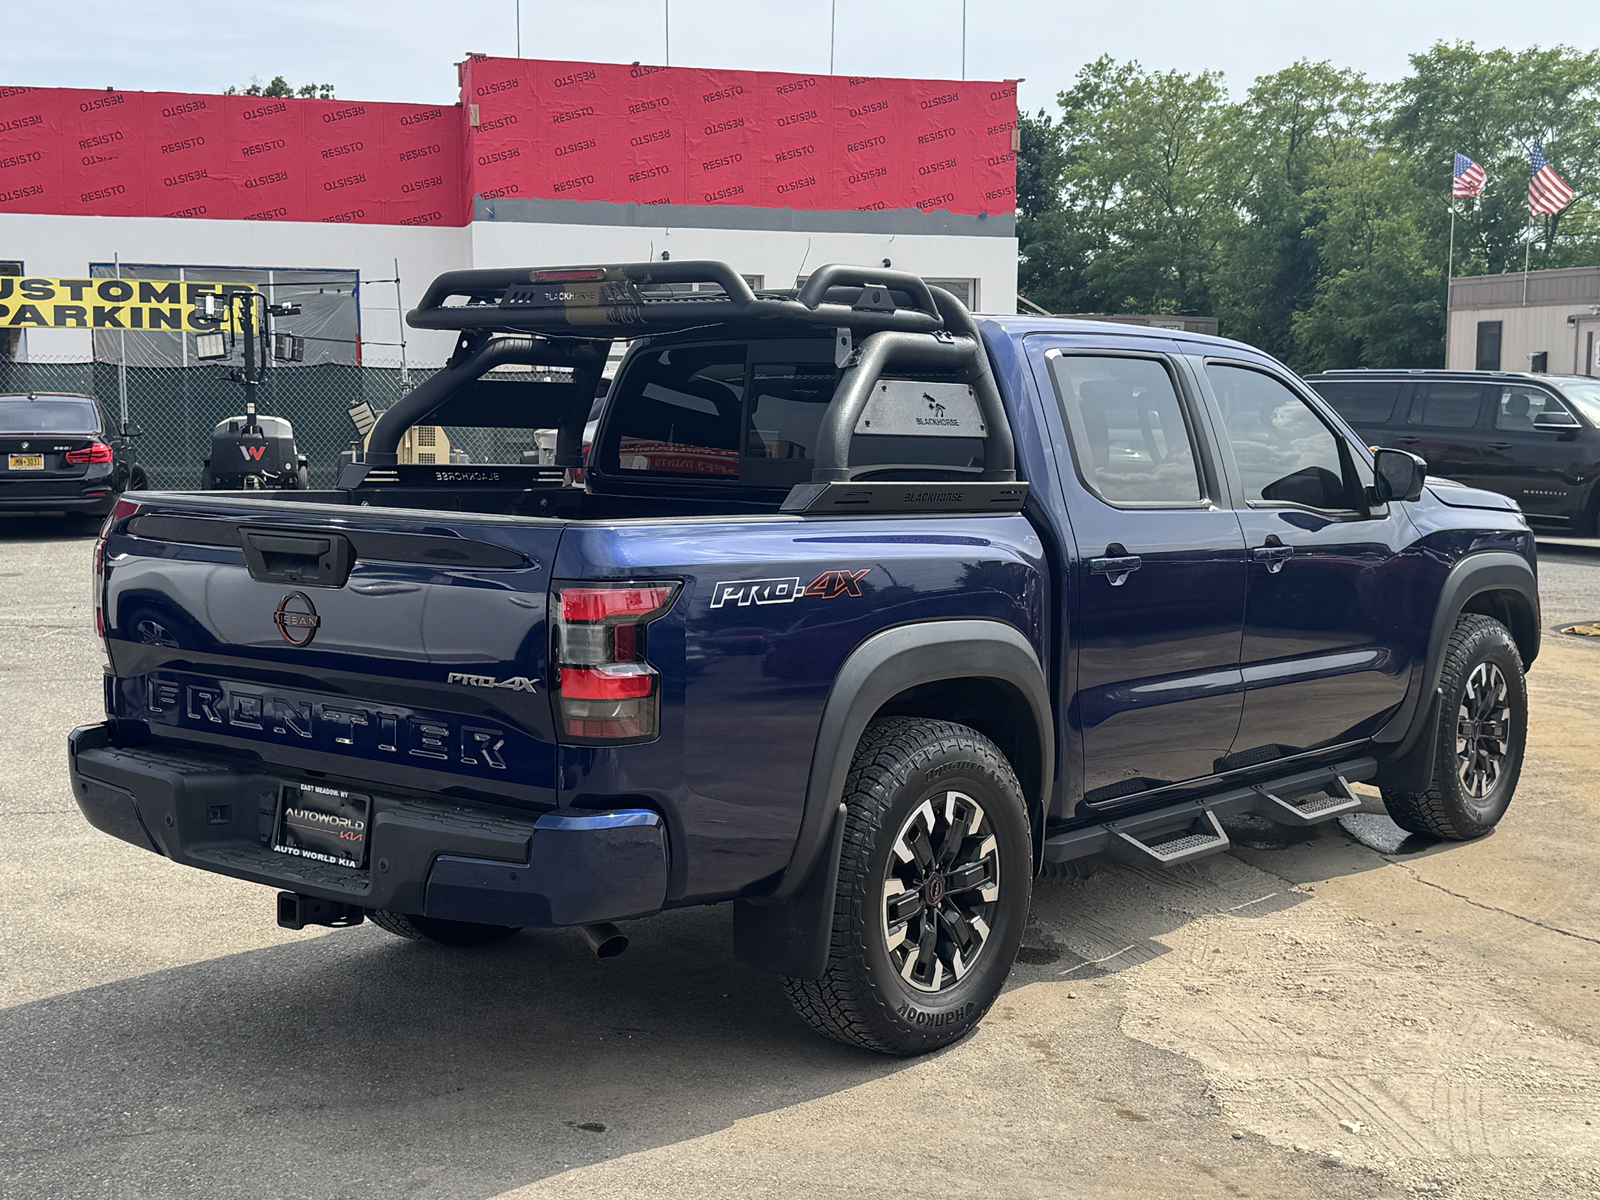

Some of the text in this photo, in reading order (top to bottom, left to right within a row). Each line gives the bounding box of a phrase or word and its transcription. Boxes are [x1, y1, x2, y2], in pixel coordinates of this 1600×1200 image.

[477, 79, 519, 96] RESISTO
[555, 70, 596, 88] RESISTO
[777, 78, 816, 95] RESISTO
[703, 86, 744, 104] RESISTO
[920, 93, 959, 110] RESISTO
[80, 95, 125, 113] RESISTO
[162, 100, 207, 118] RESISTO
[243, 102, 287, 120] RESISTO
[629, 97, 670, 114] RESISTO
[850, 101, 889, 118] RESISTO
[322, 105, 366, 123] RESISTO
[400, 109, 442, 126] RESISTO
[554, 107, 595, 124] RESISTO
[778, 110, 818, 126] RESISTO
[705, 118, 745, 135] RESISTO
[79, 132, 124, 149] RESISTO
[631, 130, 671, 147] RESISTO
[847, 135, 886, 153] RESISTO
[918, 128, 956, 145] RESISTO
[162, 137, 205, 154] RESISTO
[242, 139, 285, 157] RESISTO
[322, 142, 364, 159] RESISTO
[399, 145, 441, 161] RESISTO
[555, 139, 596, 156] RESISTO
[776, 145, 815, 162] RESISTO
[478, 148, 520, 165] RESISTO
[703, 154, 743, 171] RESISTO
[629, 165, 669, 183] RESISTO
[849, 167, 887, 184] RESISTO
[919, 159, 957, 176] RESISTO
[164, 169, 208, 187] RESISTO
[245, 171, 288, 188] RESISTO
[324, 174, 366, 191] RESISTO
[401, 176, 443, 193] RESISTO
[554, 175, 595, 193] RESISTO
[777, 177, 816, 193] RESISTO
[81, 185, 126, 202] RESISTO
[705, 185, 745, 202] RESISTO
[915, 417, 960, 427] BLACKHORSE
[904, 492, 964, 502] BLACKHORSE
[447, 671, 541, 695] PRO-4X
[146, 677, 507, 770] FRONTIER
[300, 783, 315, 792] EAST
[340, 790, 349, 799] NY
[284, 807, 365, 831] AUTOWORLD
[273, 844, 356, 869] AUTO WORLD KIA
